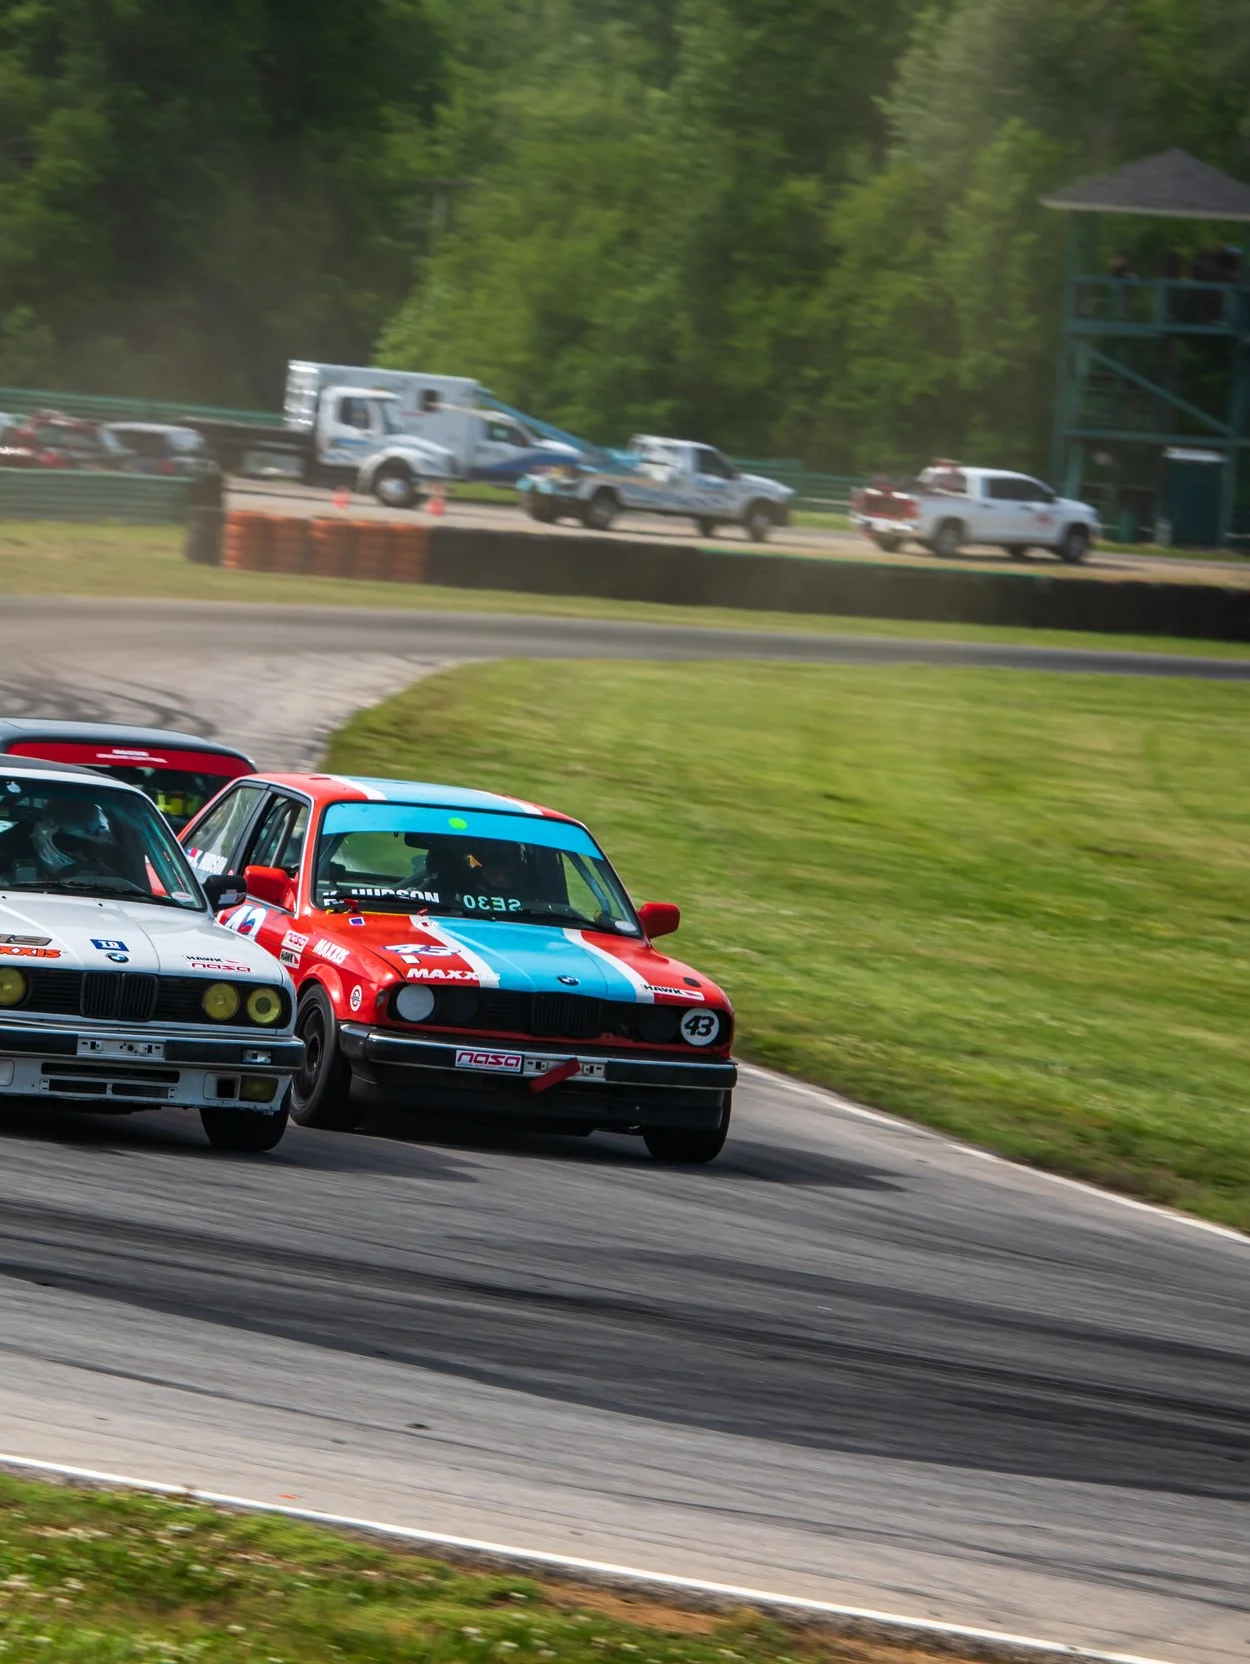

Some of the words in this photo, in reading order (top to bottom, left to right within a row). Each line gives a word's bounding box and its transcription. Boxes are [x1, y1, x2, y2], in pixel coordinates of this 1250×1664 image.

[185, 955, 224, 963] HAWK
[312, 938, 350, 966] MAXXIS
[191, 962, 252, 972] nasa
[643, 984, 682, 995] HAWK
[684, 1014, 715, 1037] 43
[456, 1051, 521, 1068] nasa
